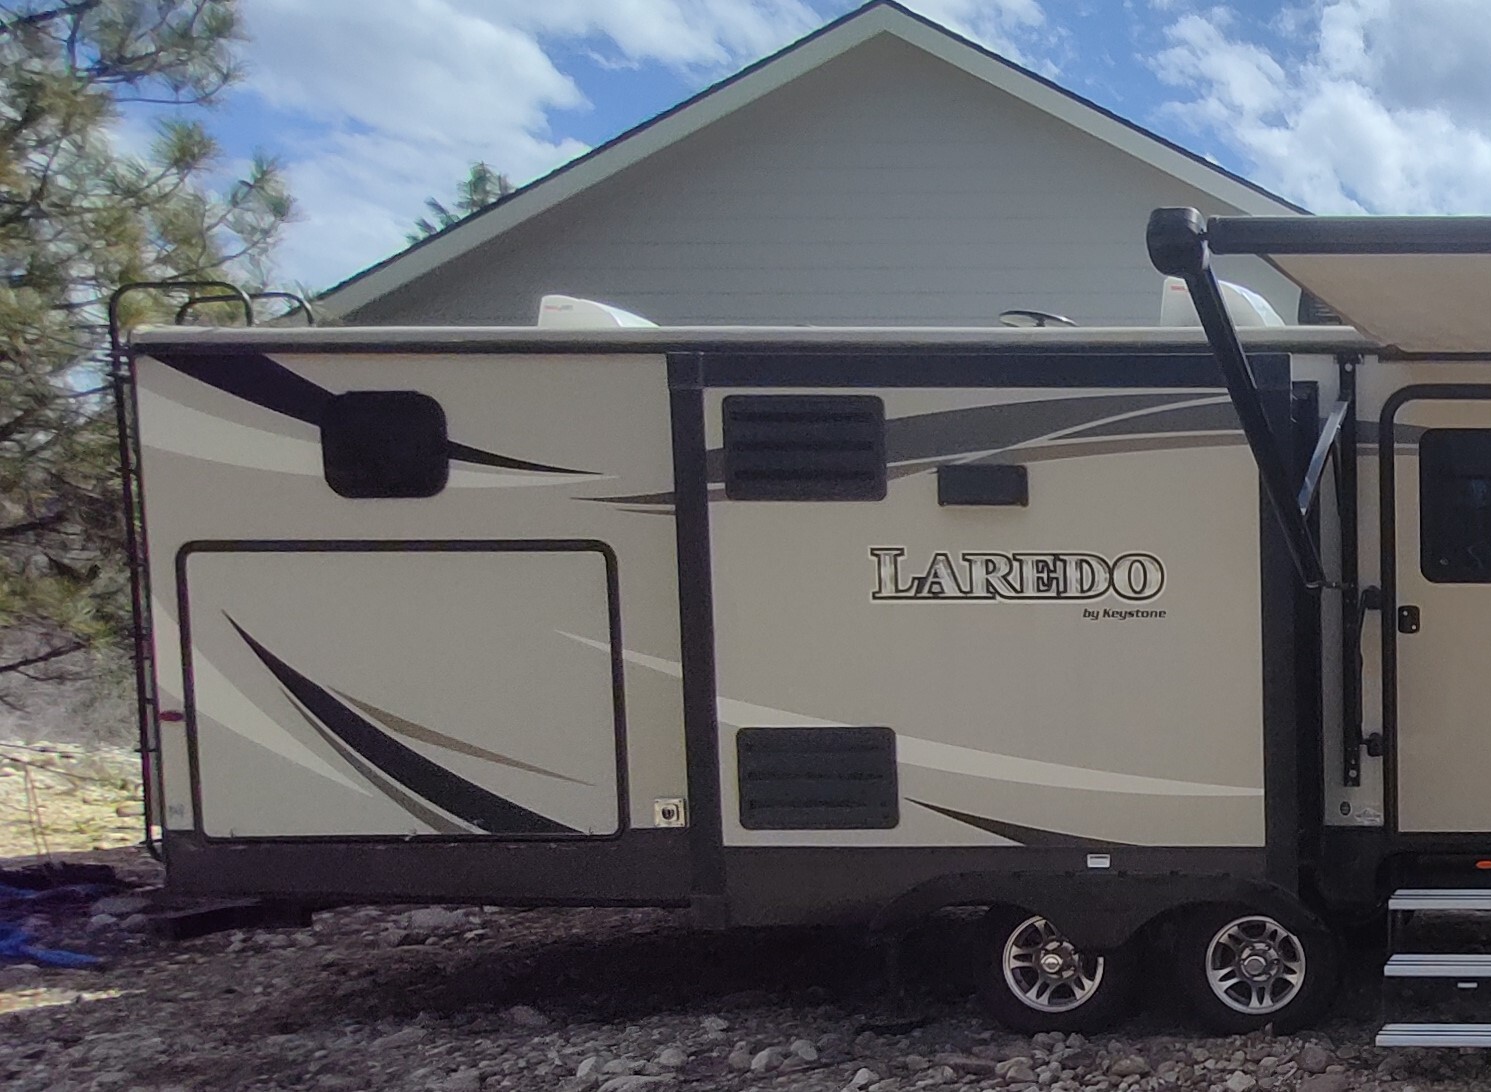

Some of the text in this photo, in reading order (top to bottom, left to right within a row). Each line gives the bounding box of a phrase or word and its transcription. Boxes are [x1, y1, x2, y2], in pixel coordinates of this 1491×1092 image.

[870, 547, 1165, 601] LAREDO
[1083, 608, 1166, 620] by Keystone
